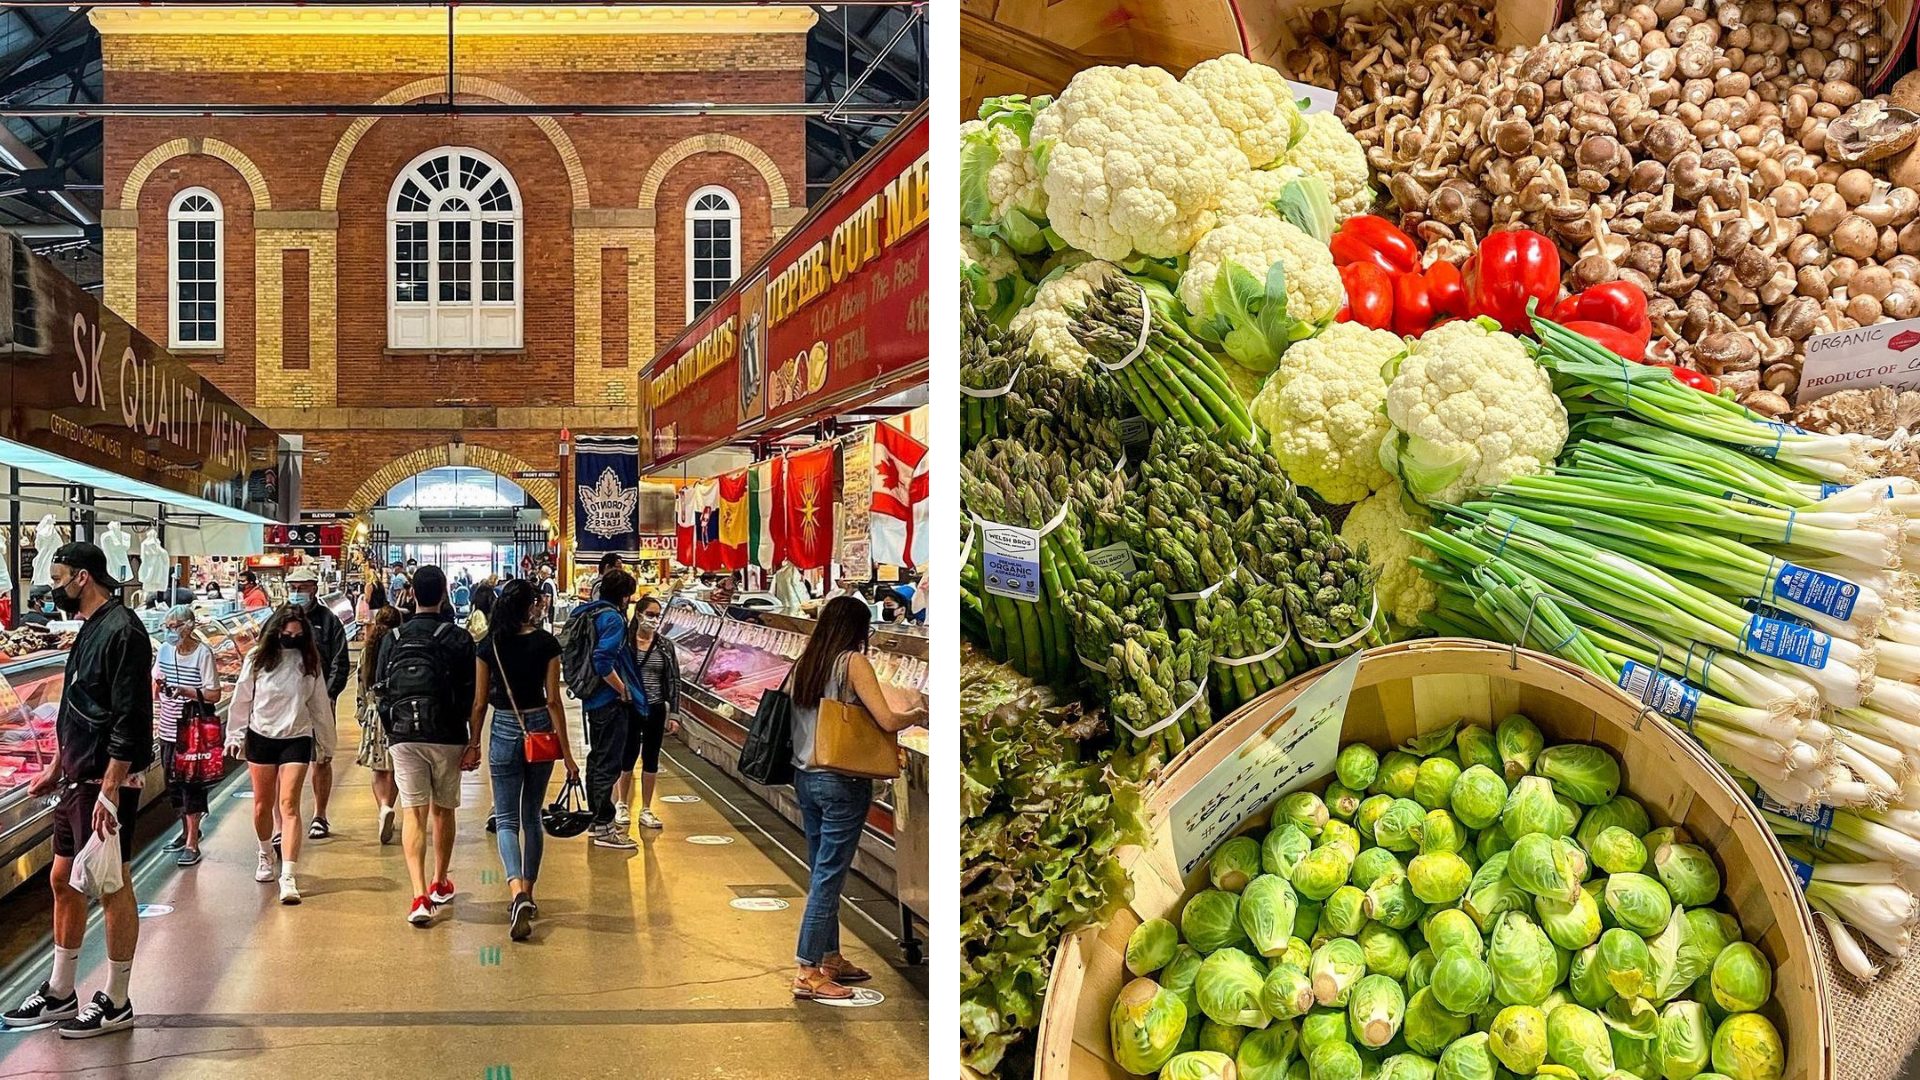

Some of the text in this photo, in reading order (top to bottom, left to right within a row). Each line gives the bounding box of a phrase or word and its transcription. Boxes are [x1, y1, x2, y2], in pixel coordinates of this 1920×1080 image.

[766, 239, 829, 328] UPPER
[830, 192, 881, 284] CUT
[871, 272, 889, 305] The
[696, 314, 737, 379] MEATS
[834, 326, 869, 371] RETAIL
[1811, 329, 1884, 352] ORGANIC
[72, 312, 248, 476] SK QUALITY MEATS
[1806, 367, 1875, 388] PRODUCT
[1877, 364, 1898, 376] OF
[988, 533, 1012, 543] WELSH
[1012, 538, 1031, 546] BROS
[989, 561, 1032, 575] ORGANIC
[1185, 695, 1342, 827] PRODUCT OF
[1246, 761, 1316, 815] Sprouts
